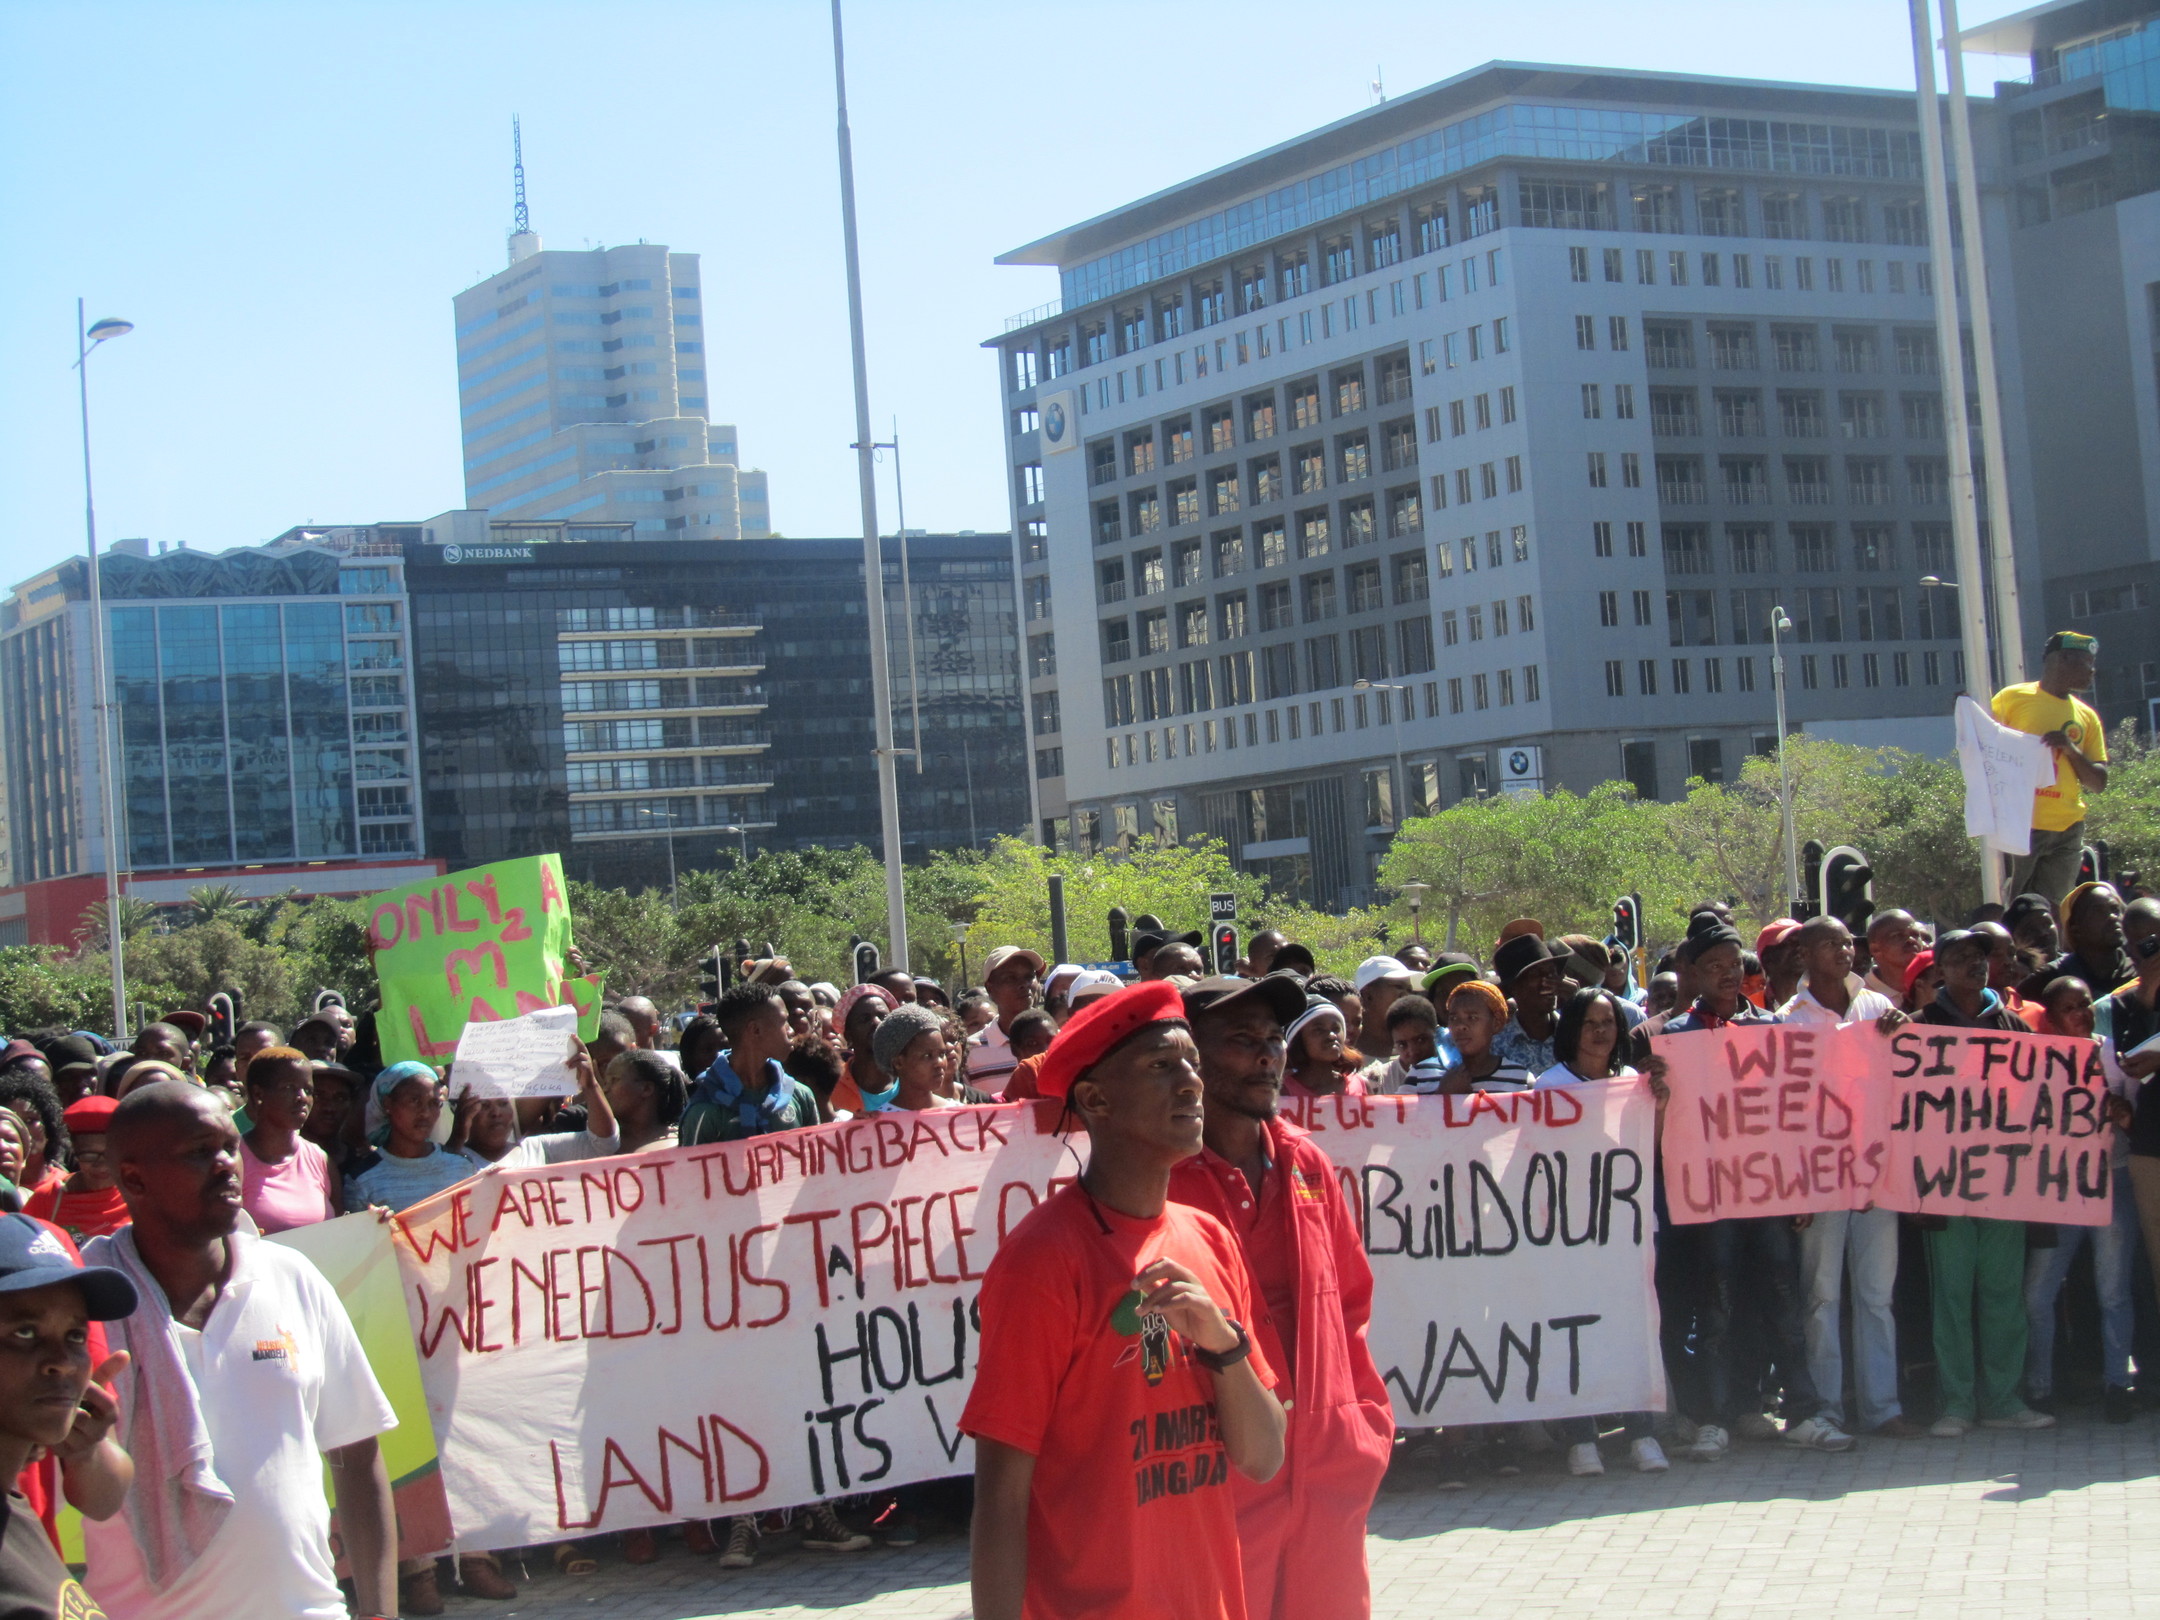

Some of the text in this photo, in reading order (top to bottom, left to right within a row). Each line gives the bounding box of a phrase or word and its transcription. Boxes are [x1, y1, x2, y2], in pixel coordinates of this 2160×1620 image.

[465, 548, 532, 558] NEDBANK
[370, 862, 563, 950] ONLY A
[500, 907, 533, 943] 2
[1212, 900, 1234, 912] BUS
[444, 940, 509, 1000] M
[1725, 1029, 1816, 1082] WE
[1700, 1081, 1853, 1142] NEED
[401, 1188, 479, 1263] WE
[492, 1177, 573, 1232] ARE
[581, 1161, 674, 1227] NOT
[1443, 1089, 1582, 1128] LAND
[1682, 1140, 1885, 1213] UNSWERS
[1913, 1142, 2109, 1202] WETHU
[637, 1209, 841, 1335] JUST
[851, 1187, 984, 1300] PIECE
[550, 1414, 769, 1529] LAND
[1383, 1314, 1602, 1416] WANT
